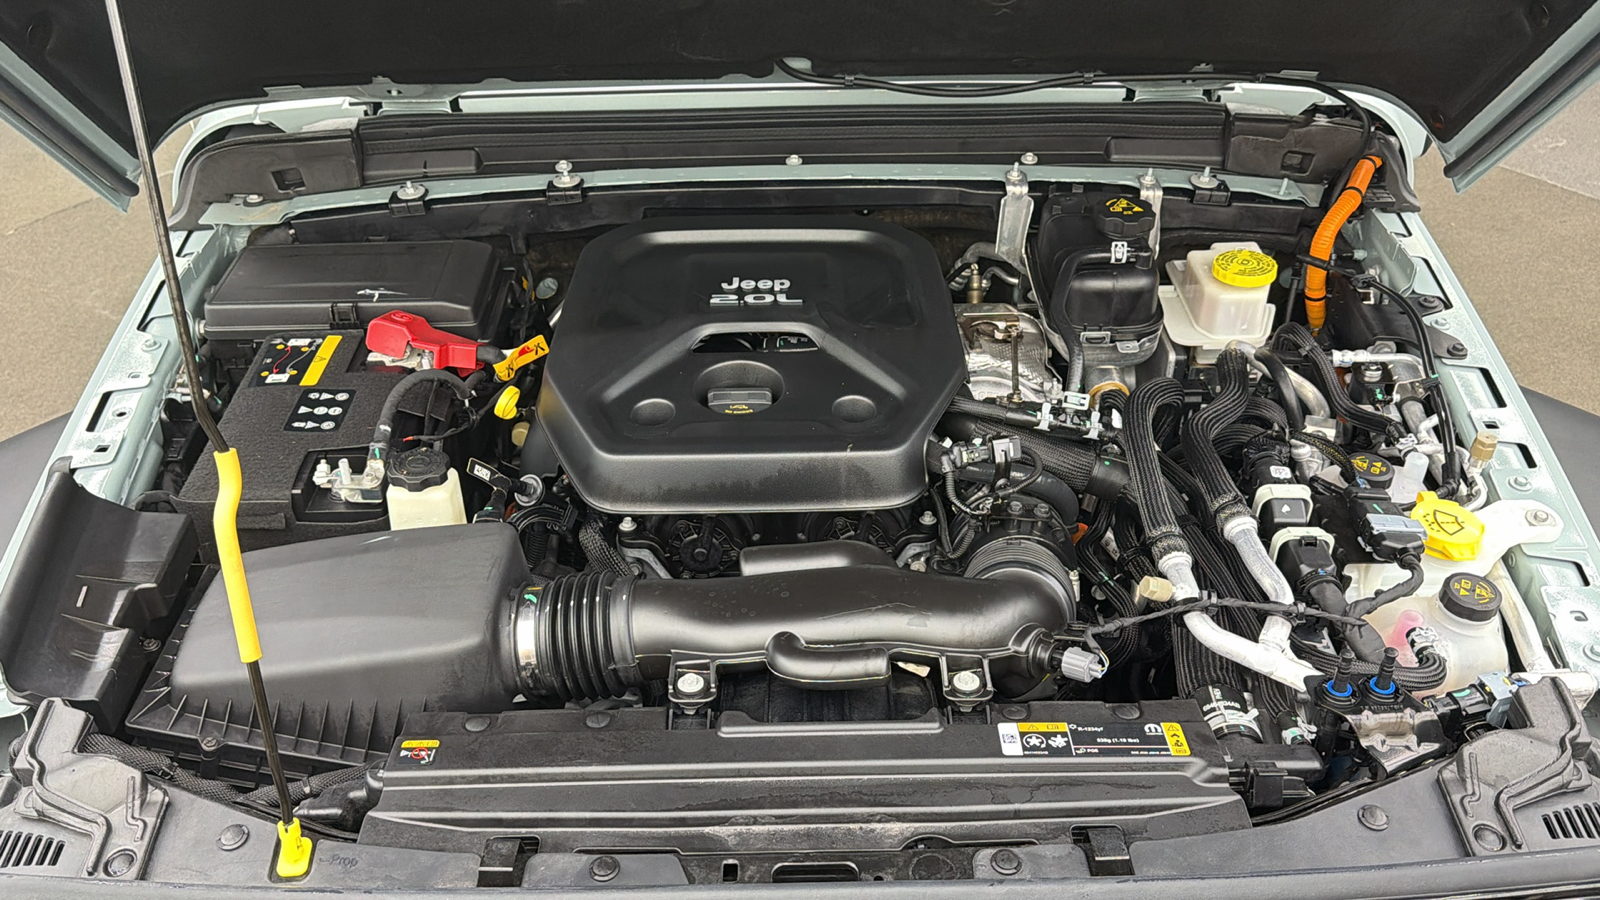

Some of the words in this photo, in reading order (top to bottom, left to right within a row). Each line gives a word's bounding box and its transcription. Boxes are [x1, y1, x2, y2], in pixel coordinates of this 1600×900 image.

[721, 277, 791, 291] Jeep
[710, 293, 803, 304] 2.0L
[330, 853, 358, 868] Prop
